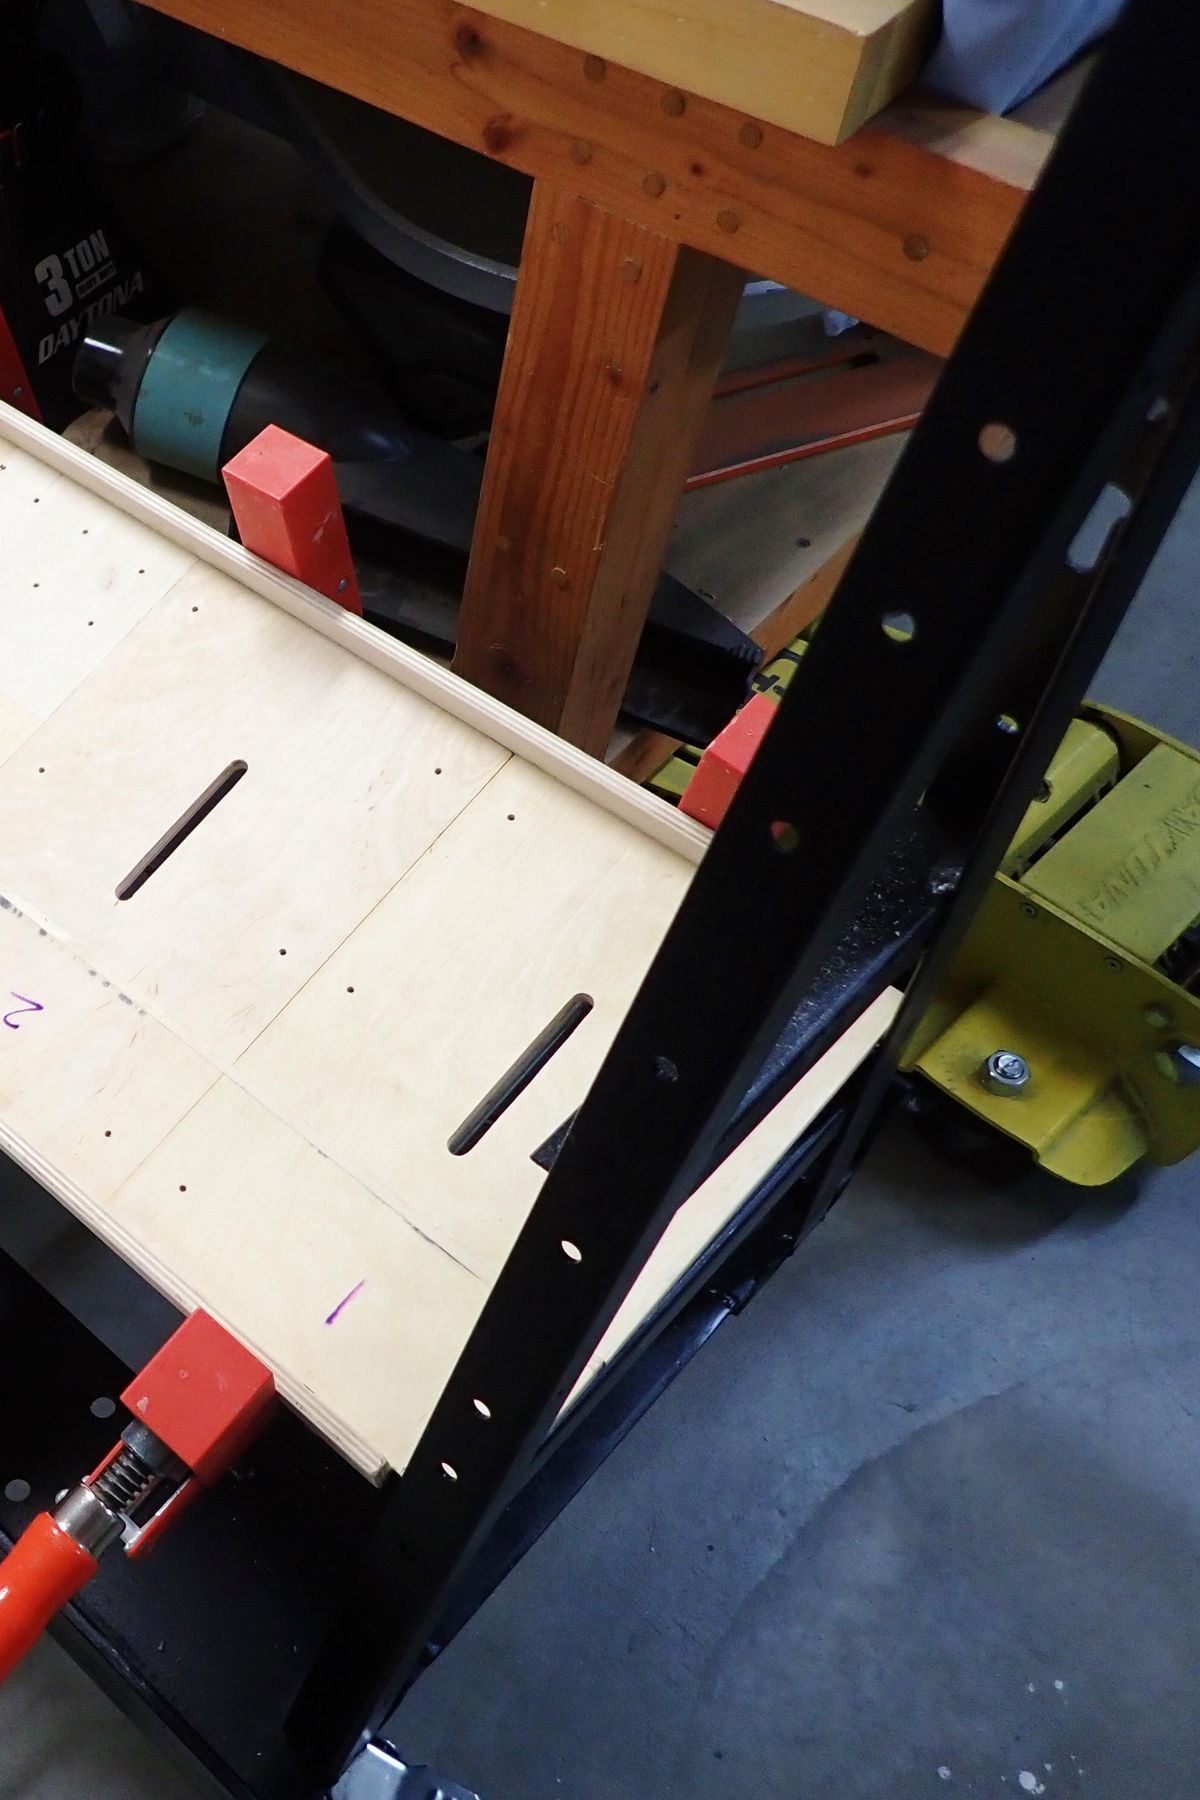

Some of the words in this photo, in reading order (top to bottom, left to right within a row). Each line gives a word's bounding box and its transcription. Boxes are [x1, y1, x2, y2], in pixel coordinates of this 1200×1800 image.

[34, 253, 73, 317] 3
[62, 228, 110, 279] TON
[38, 271, 145, 365] DAYTONA
[2, 991, 44, 1030] 2
[324, 1276, 367, 1327] 1
